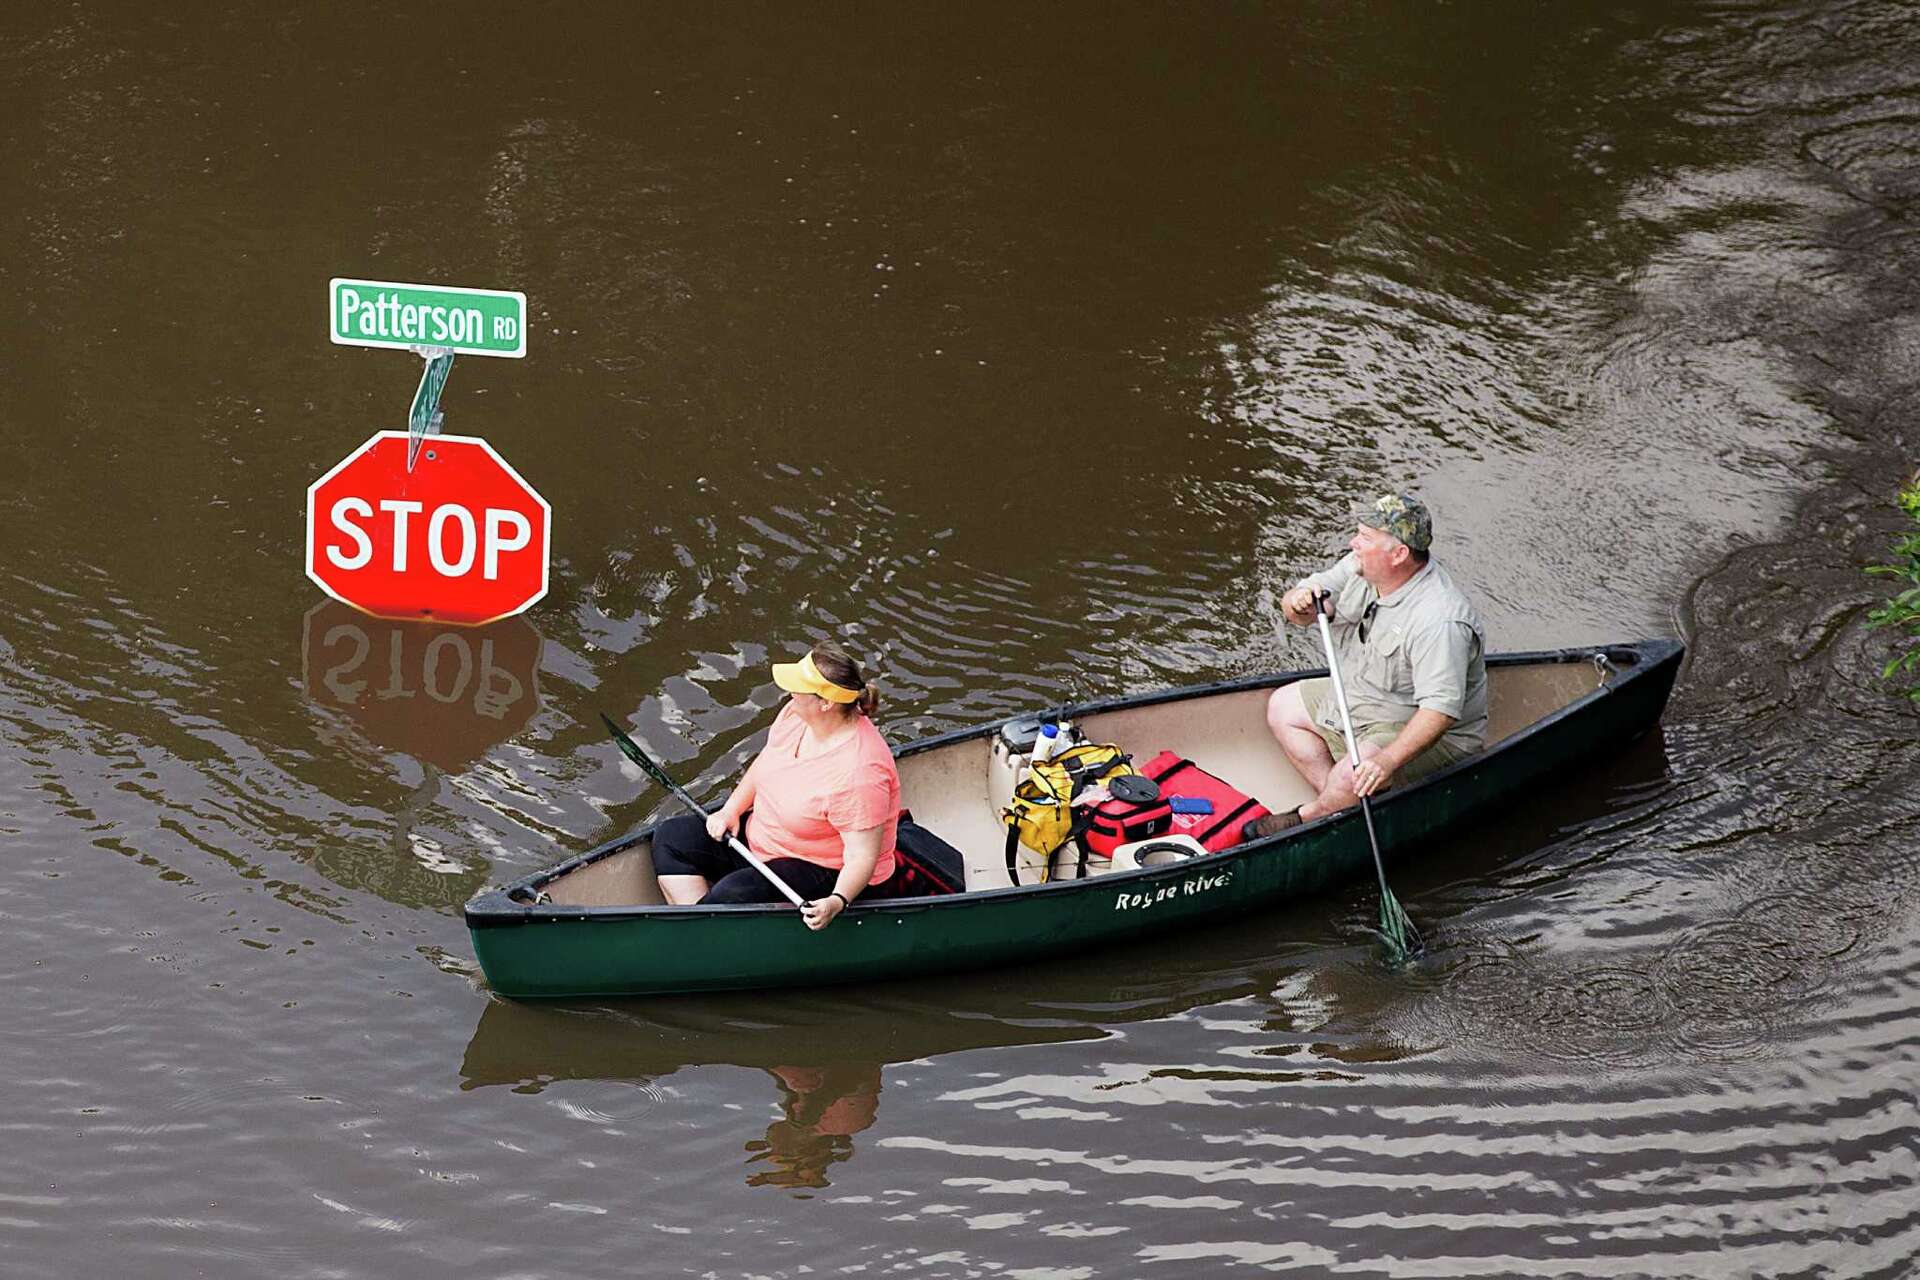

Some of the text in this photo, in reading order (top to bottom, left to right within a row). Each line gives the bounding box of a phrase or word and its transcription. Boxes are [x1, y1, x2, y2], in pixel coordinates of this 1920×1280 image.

[341, 288, 518, 344] Patterson RD
[325, 496, 532, 581] STOP
